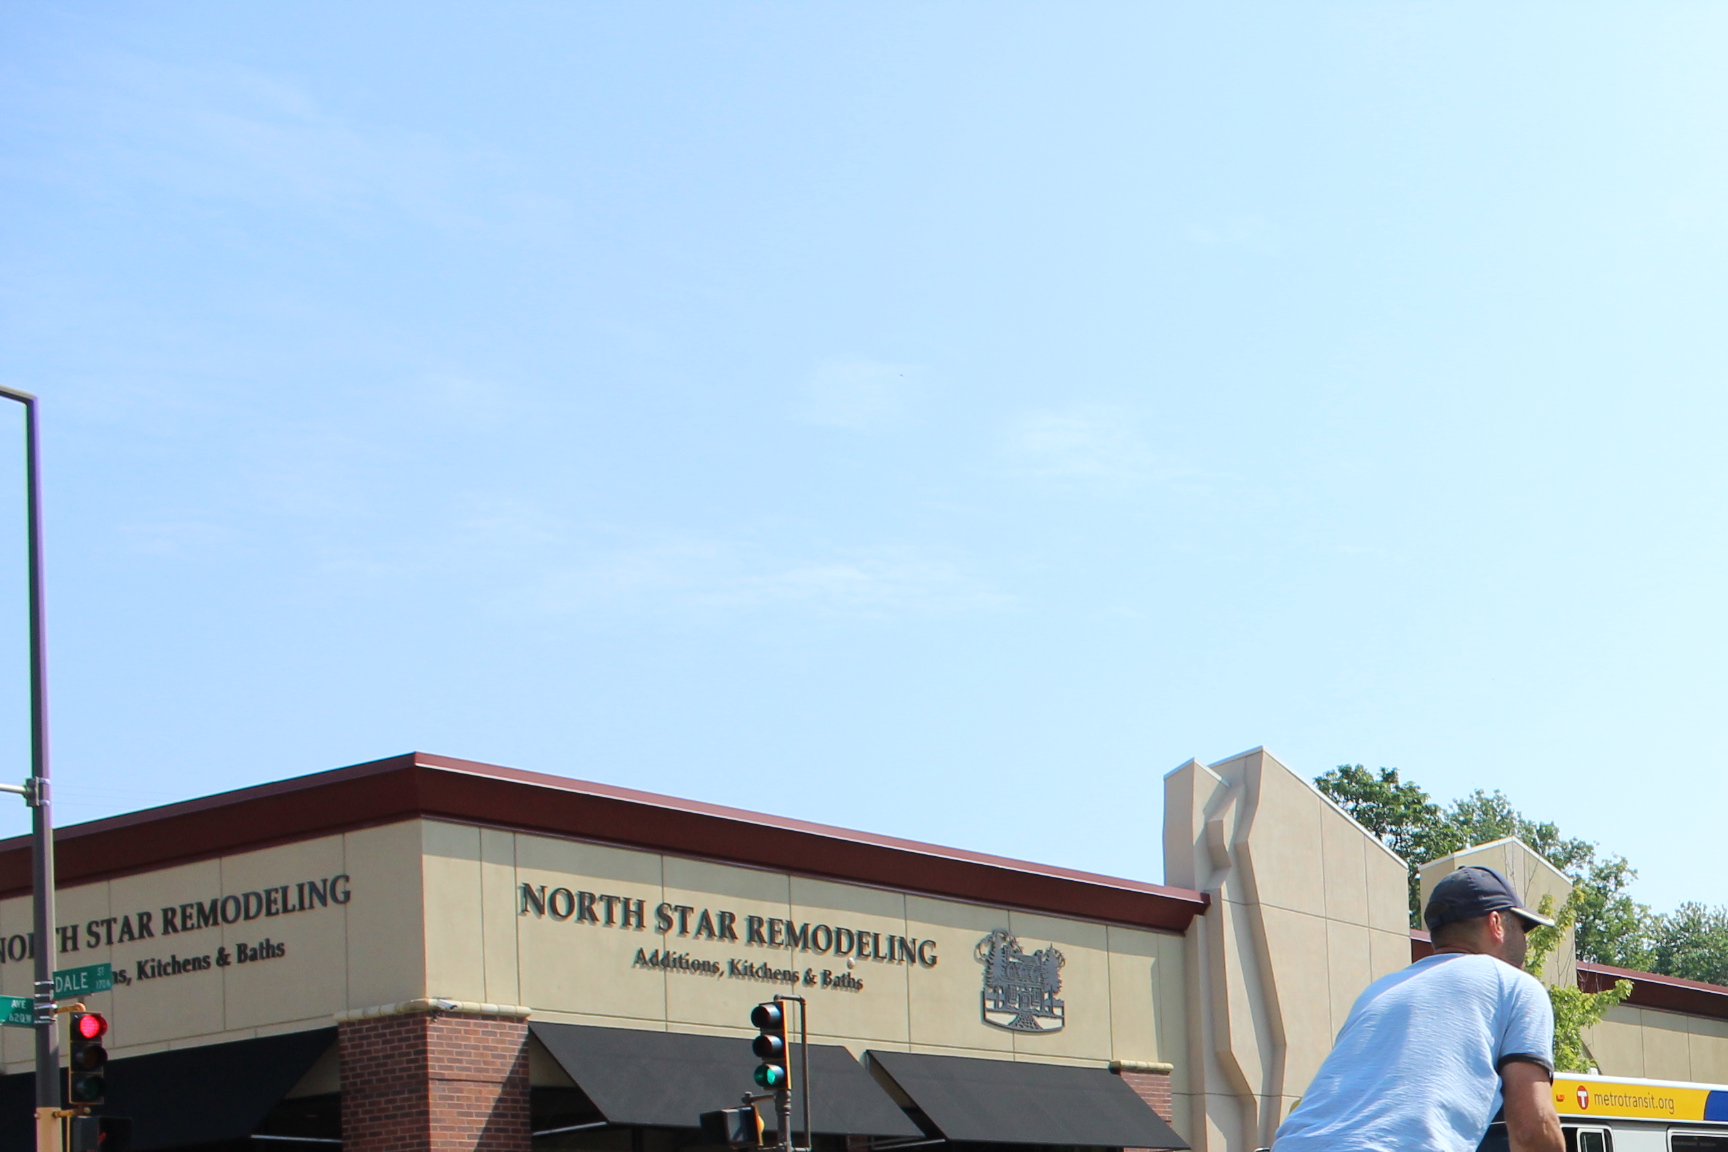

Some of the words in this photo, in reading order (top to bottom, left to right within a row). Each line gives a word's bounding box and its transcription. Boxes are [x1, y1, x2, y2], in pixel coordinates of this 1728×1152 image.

[86, 911, 155, 949] STAR
[160, 874, 351, 936] REMODELING
[521, 882, 646, 930] NORTH
[655, 902, 738, 941] STAR
[747, 914, 938, 968] REMODELING
[137, 954, 211, 981] Kitchens
[216, 946, 231, 967] &
[235, 938, 285, 964] Baths
[728, 958, 800, 985] Kitchens
[803, 968, 818, 988] &
[821, 968, 864, 993] Baths
[54, 972, 88, 993] DALE
[11, 1000, 26, 1009] AVE
[1594, 1092, 1675, 1115] metrotransit.org
